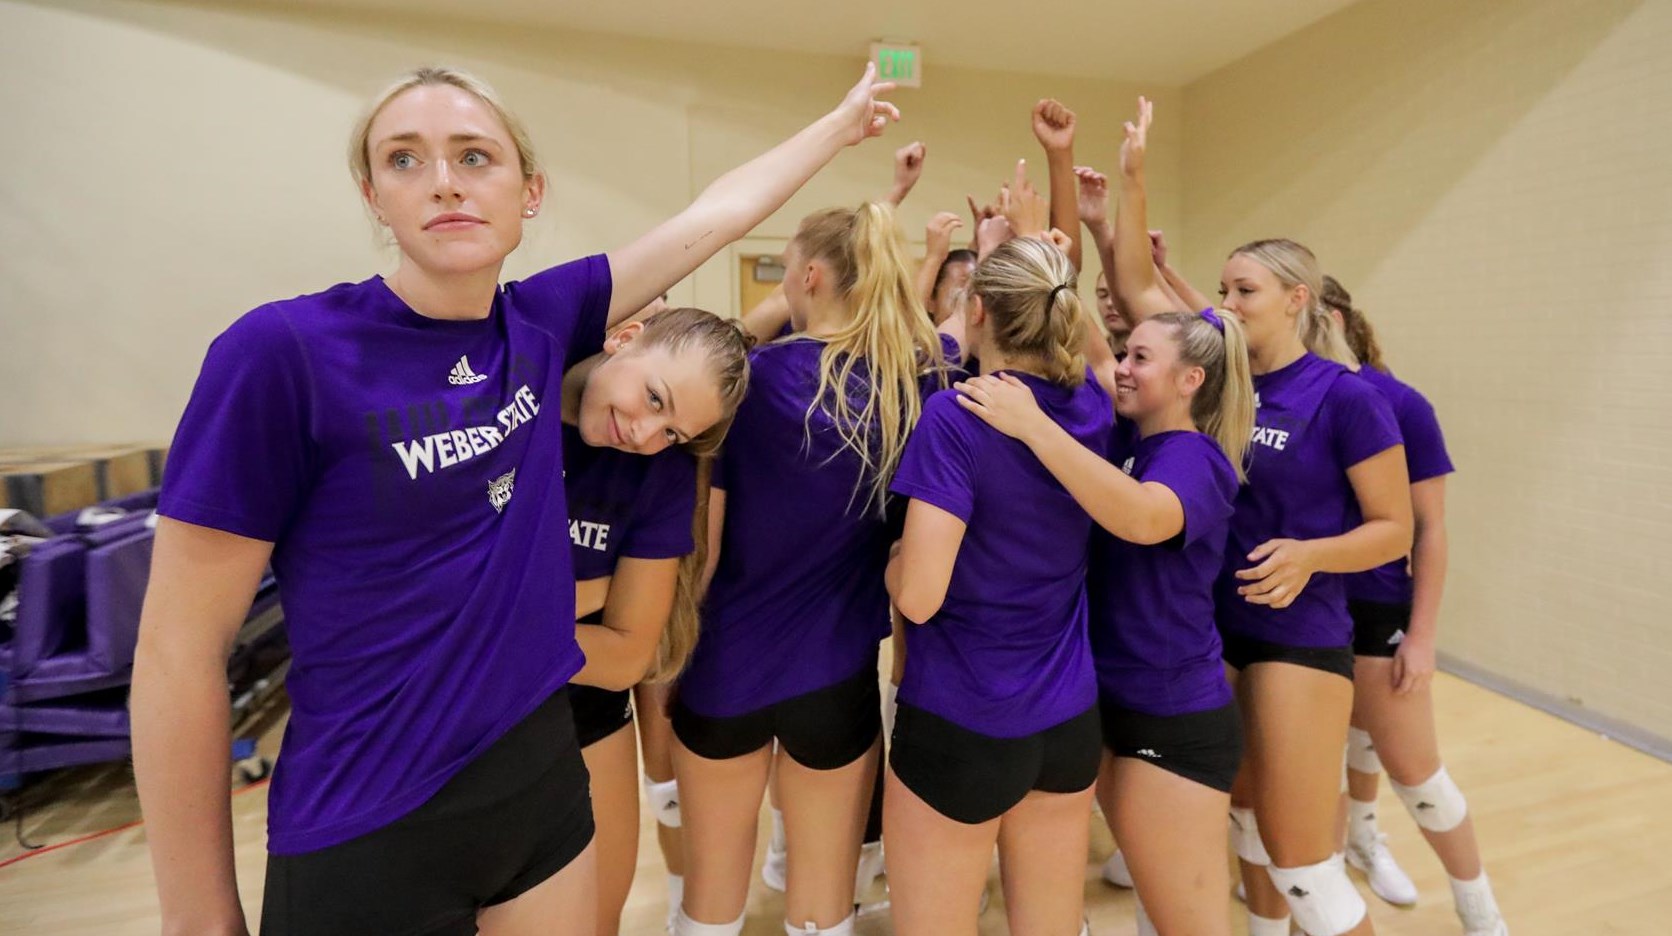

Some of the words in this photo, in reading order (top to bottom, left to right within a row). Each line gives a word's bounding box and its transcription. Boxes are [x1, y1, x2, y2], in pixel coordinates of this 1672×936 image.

[878, 48, 914, 80] EXIT
[392, 425, 505, 481] WEBER
[496, 384, 541, 438] STATE
[567, 518, 611, 552] ATE
